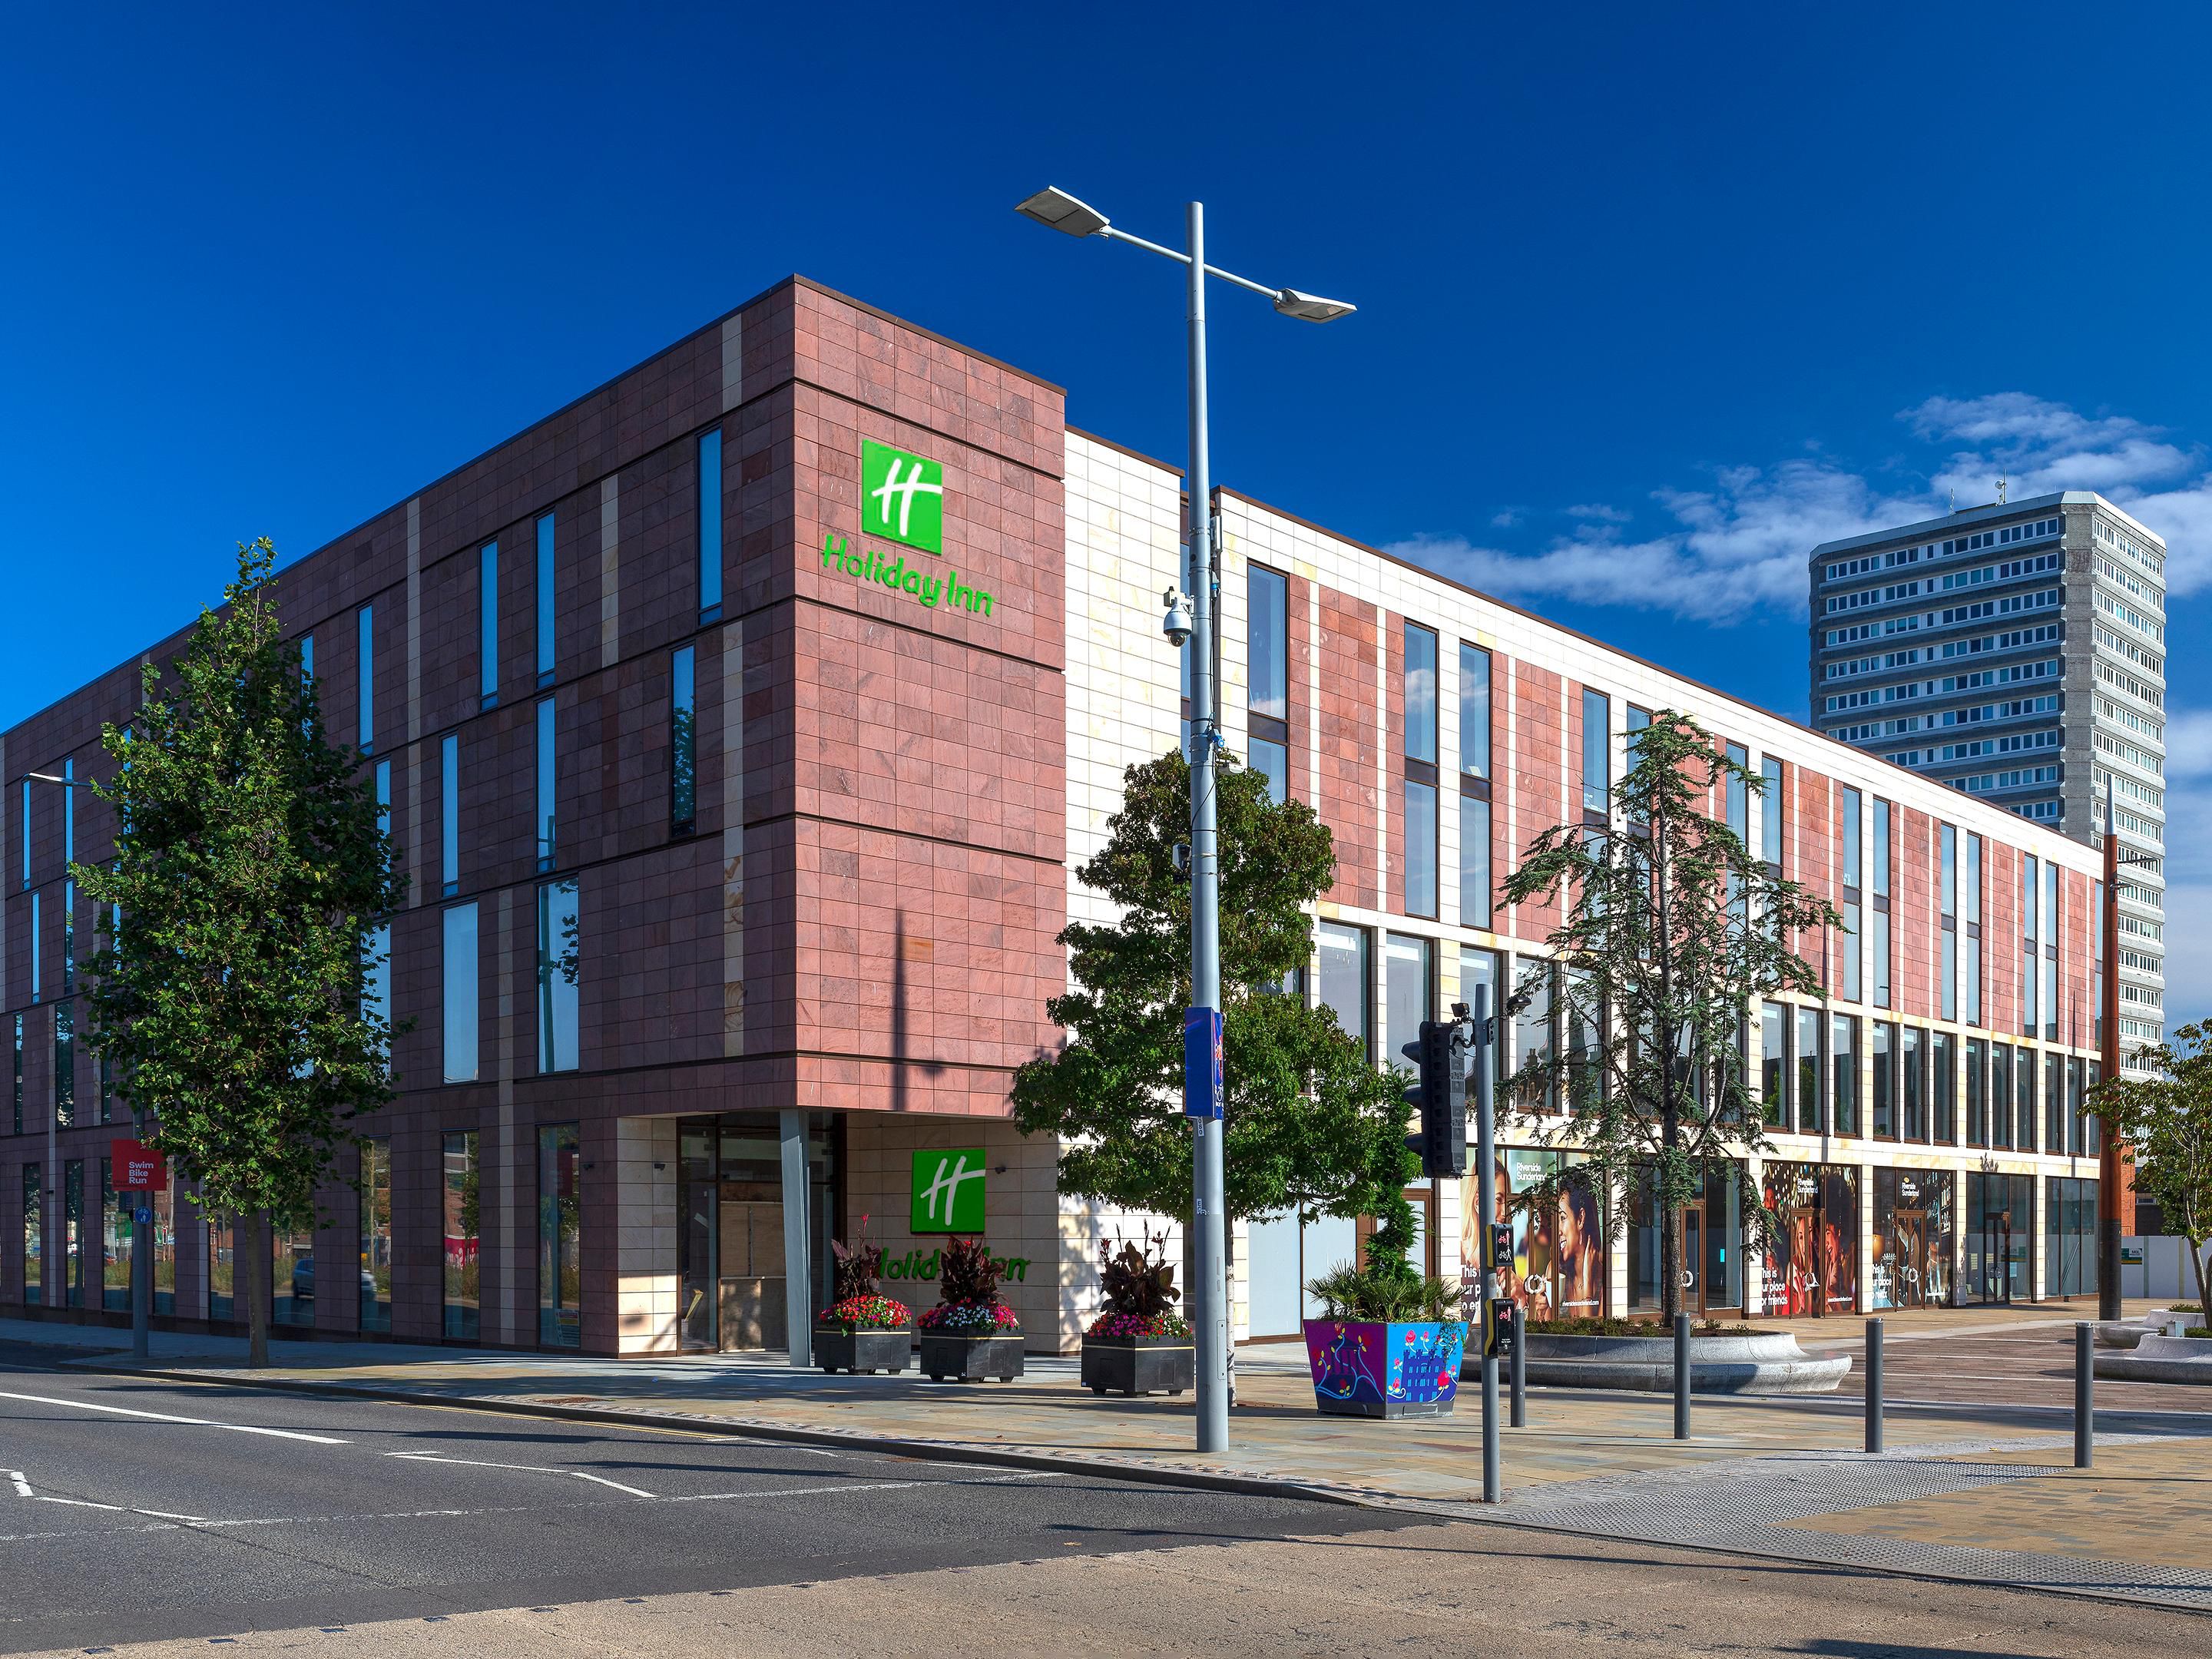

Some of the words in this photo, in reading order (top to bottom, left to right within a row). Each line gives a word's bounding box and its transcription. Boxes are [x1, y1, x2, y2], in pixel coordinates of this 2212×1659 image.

[821, 534, 942, 608] Holiday
[947, 571, 995, 617] Inn
[1517, 1162, 1541, 1172] Riverside
[1797, 1185, 1818, 1194] Sunderland
[879, 1247, 942, 1280] olid
[1762, 1267, 1771, 1279] his
[1769, 1281, 1786, 1294] place
[1767, 1294, 1788, 1306] friends
